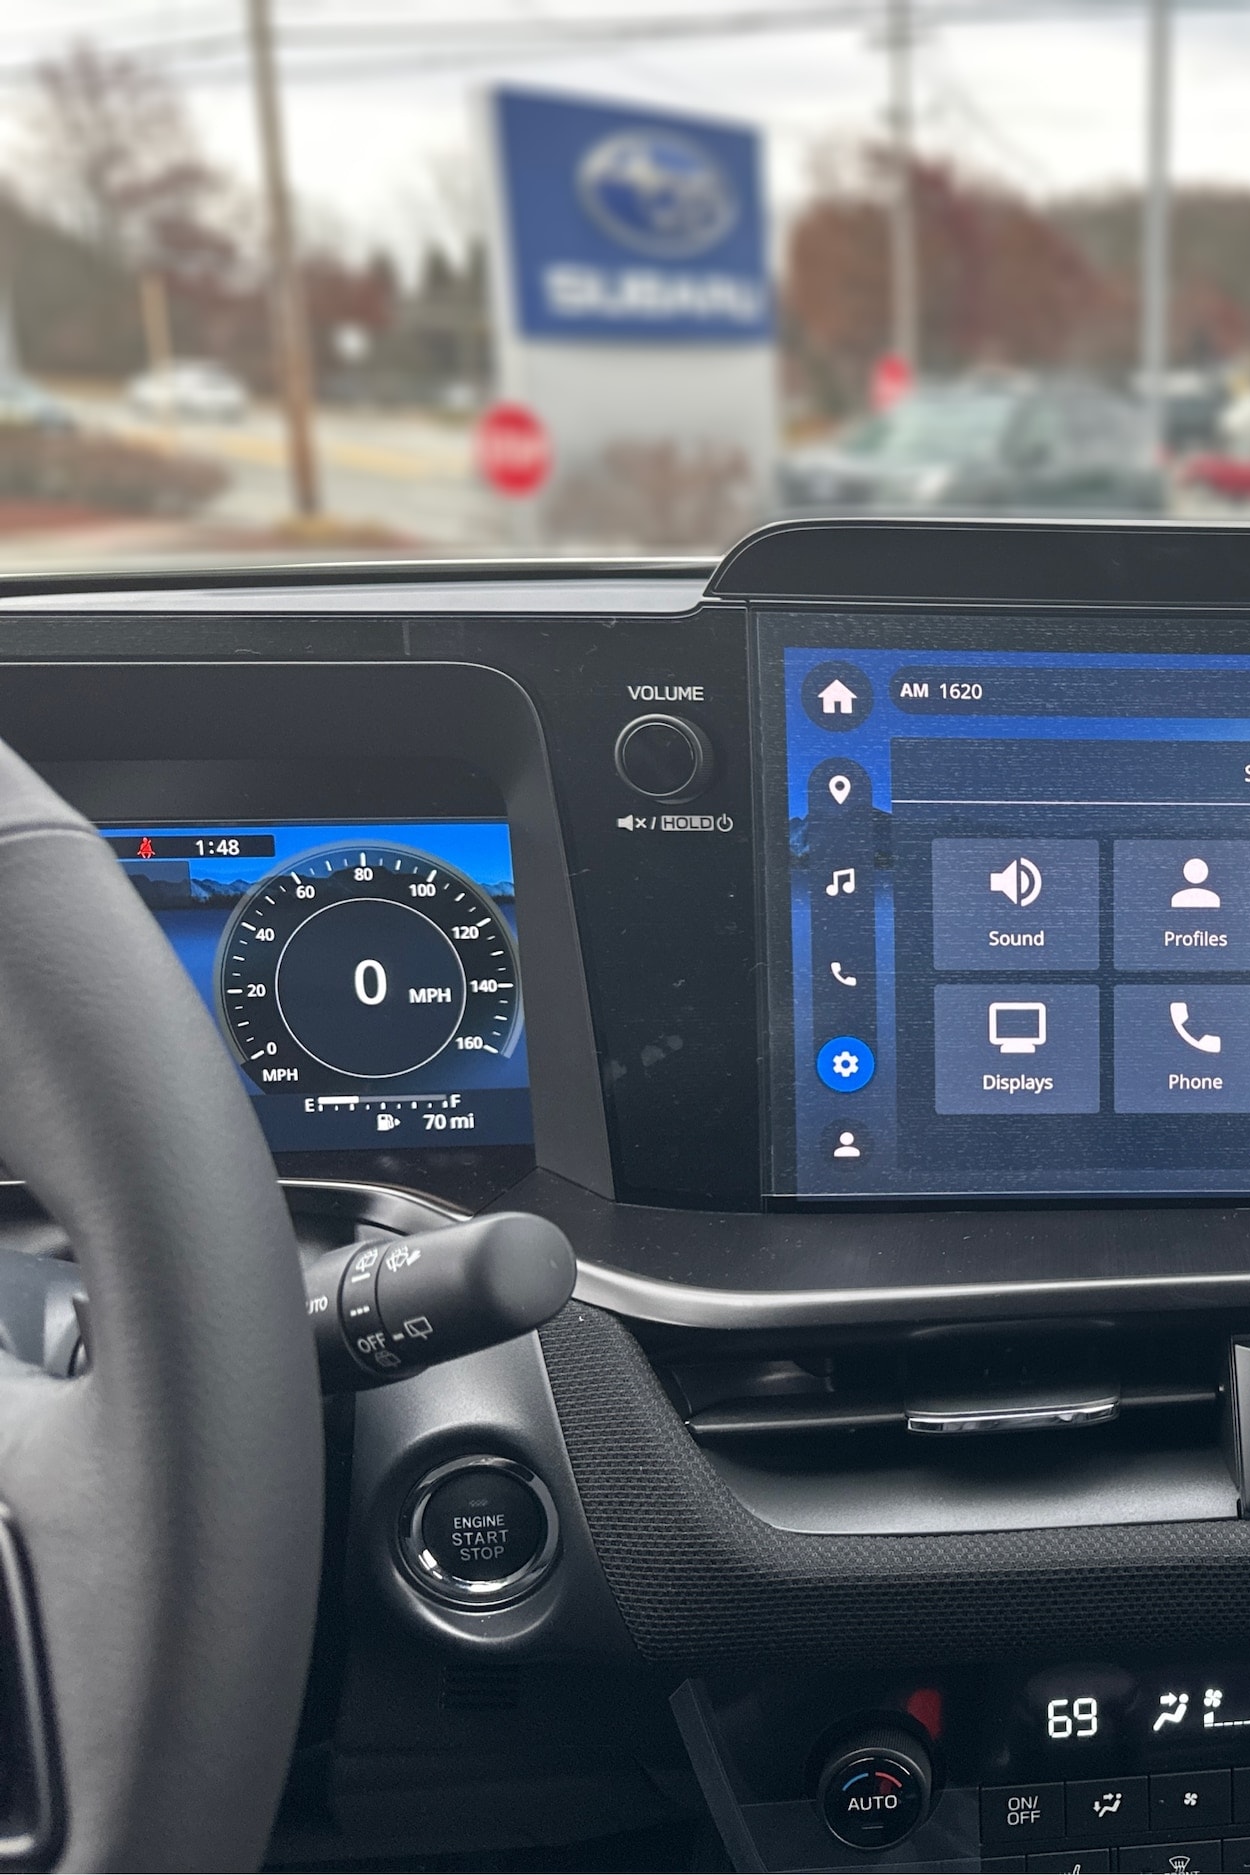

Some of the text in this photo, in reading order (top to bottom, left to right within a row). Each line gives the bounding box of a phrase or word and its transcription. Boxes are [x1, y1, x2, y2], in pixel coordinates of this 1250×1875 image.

[627, 685, 705, 701] VOLUME
[900, 683, 983, 700] AM 1620
[663, 816, 713, 830] HOLD
[195, 838, 240, 857] 1:48
[354, 867, 374, 882] 80
[296, 884, 316, 900] 60
[408, 883, 437, 898] 100
[255, 927, 275, 943] 40
[452, 924, 480, 940] 120
[988, 930, 1045, 947] Sound
[1164, 931, 1228, 948] Profiles
[247, 982, 267, 998] 20
[354, 959, 388, 1006] 0
[470, 979, 498, 994] 140
[409, 987, 451, 1004] MPH
[266, 1041, 278, 1056] 0
[456, 1036, 483, 1051] 160
[262, 1067, 299, 1083] MPH
[1168, 1074, 1223, 1090] Phone
[983, 1074, 1054, 1095] Displays
[305, 1098, 315, 1114] E
[450, 1093, 461, 1109] F
[422, 1112, 475, 1131] 70 mi
[357, 1332, 386, 1354] OFF
[453, 1513, 505, 1530] ENGINE
[451, 1529, 509, 1547] START
[460, 1545, 505, 1561] STOP
[1047, 1697, 1099, 1739] 69
[847, 1794, 898, 1812] AUTO
[1007, 1796, 1039, 1812] ON/
[1007, 1810, 1041, 1826] OFF
